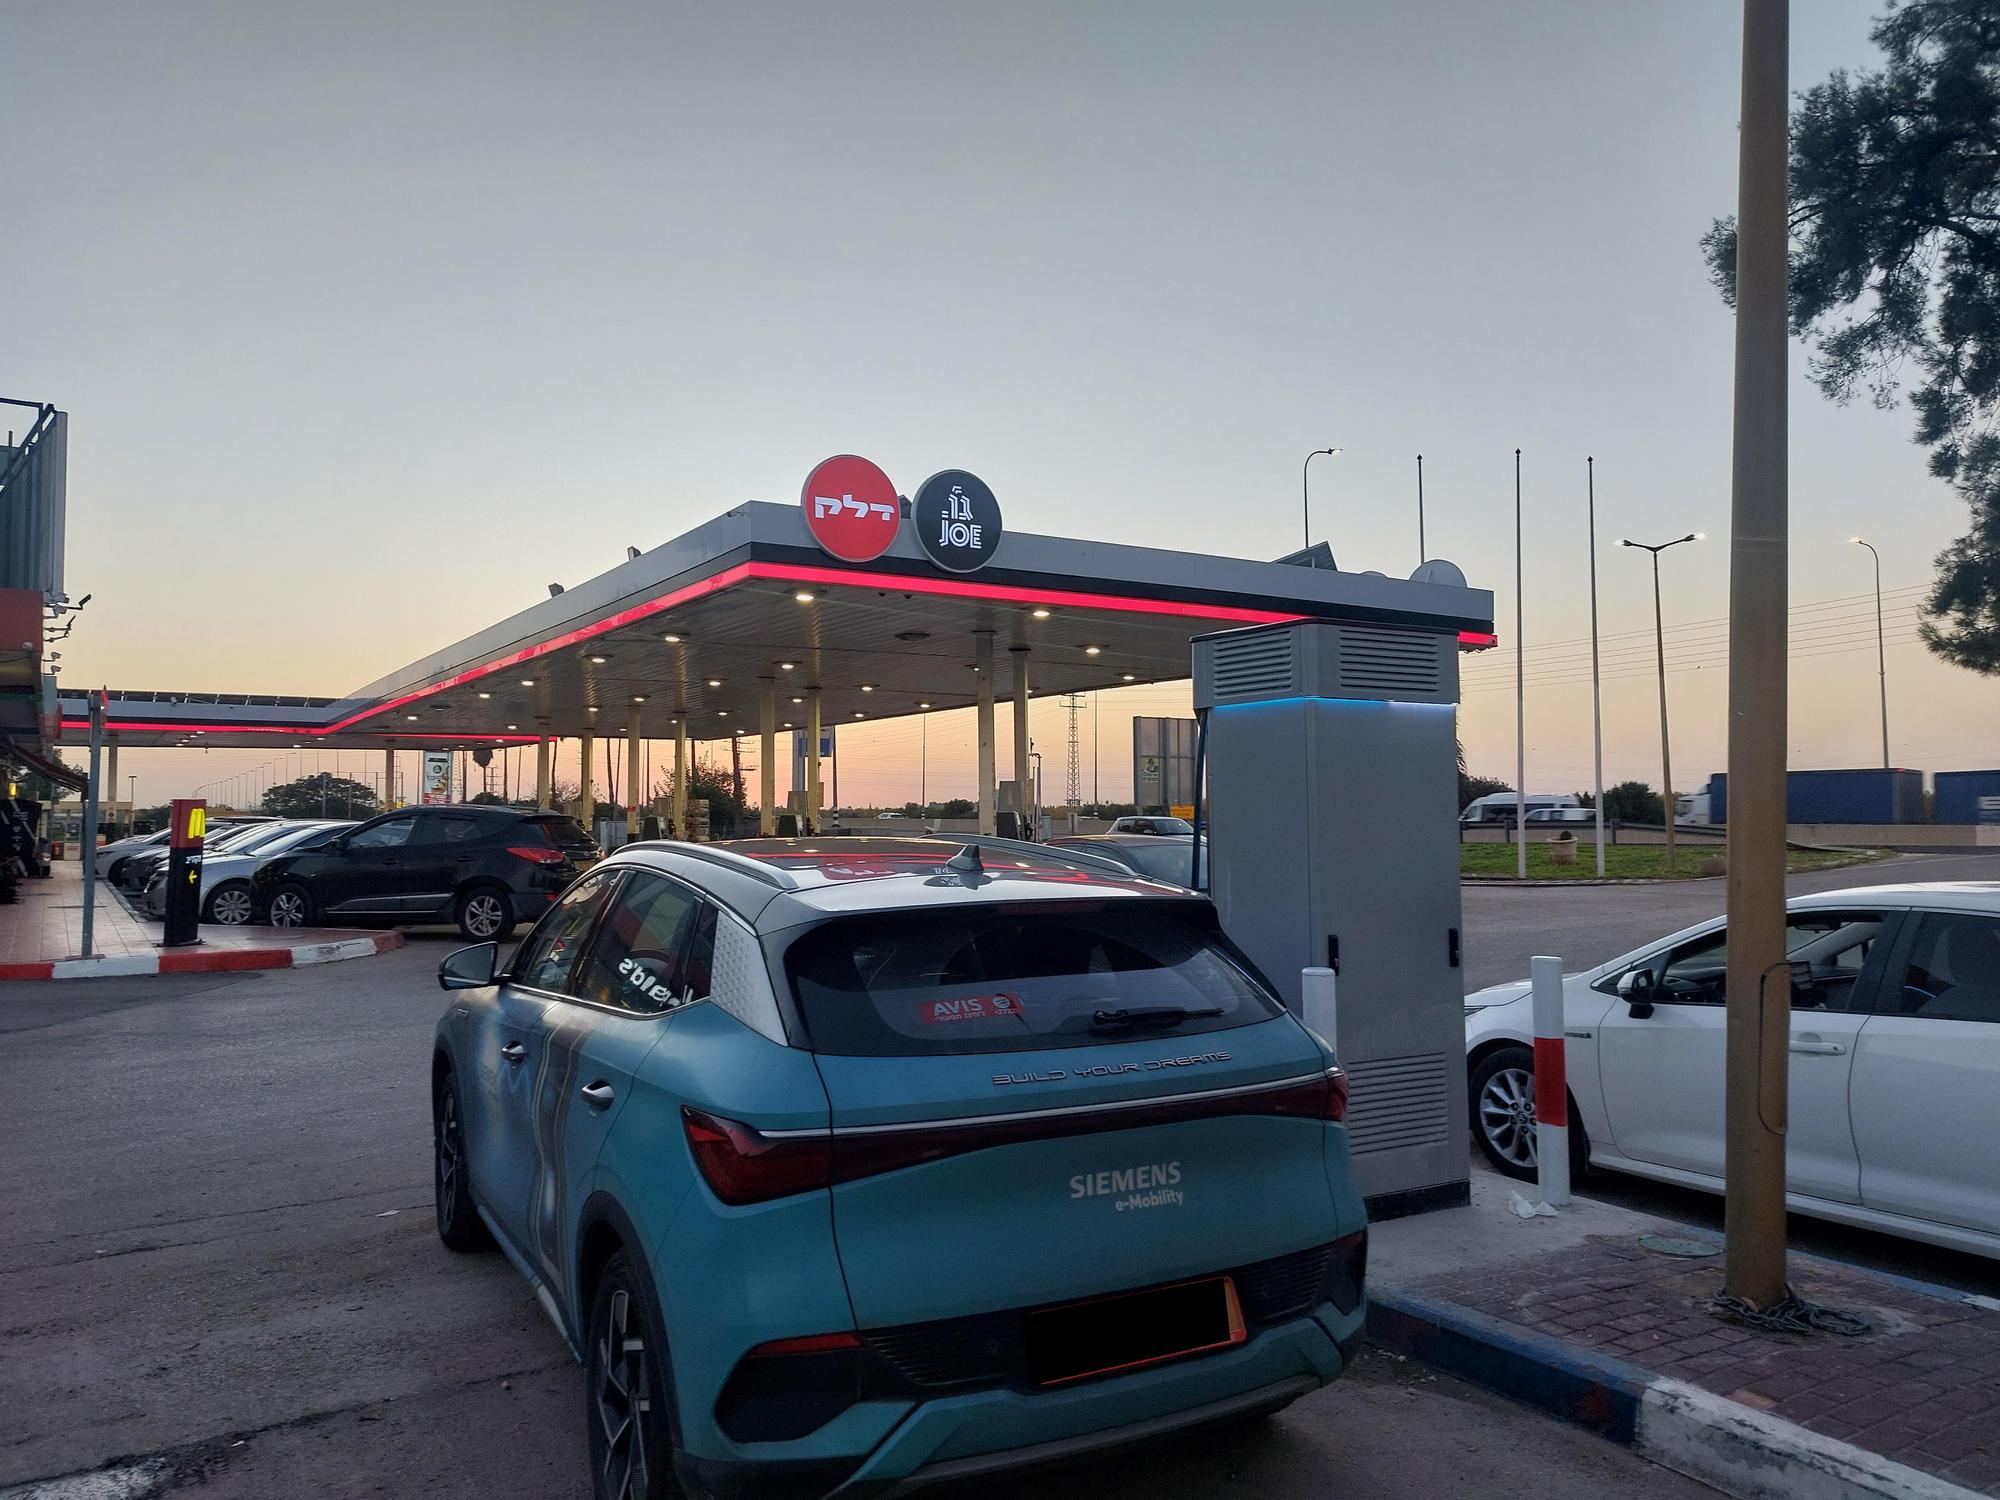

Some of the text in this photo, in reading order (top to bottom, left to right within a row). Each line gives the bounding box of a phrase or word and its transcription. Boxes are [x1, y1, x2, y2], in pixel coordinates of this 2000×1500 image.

[814, 494, 895, 521] דלק
[939, 519, 982, 549] JOE
[934, 999, 983, 1016] AVIS
[992, 1050, 1233, 1085] BUILD YOUR DREAMS
[1069, 1161, 1182, 1199] SIEMENS
[1115, 1189, 1183, 1212] e-Mobility
